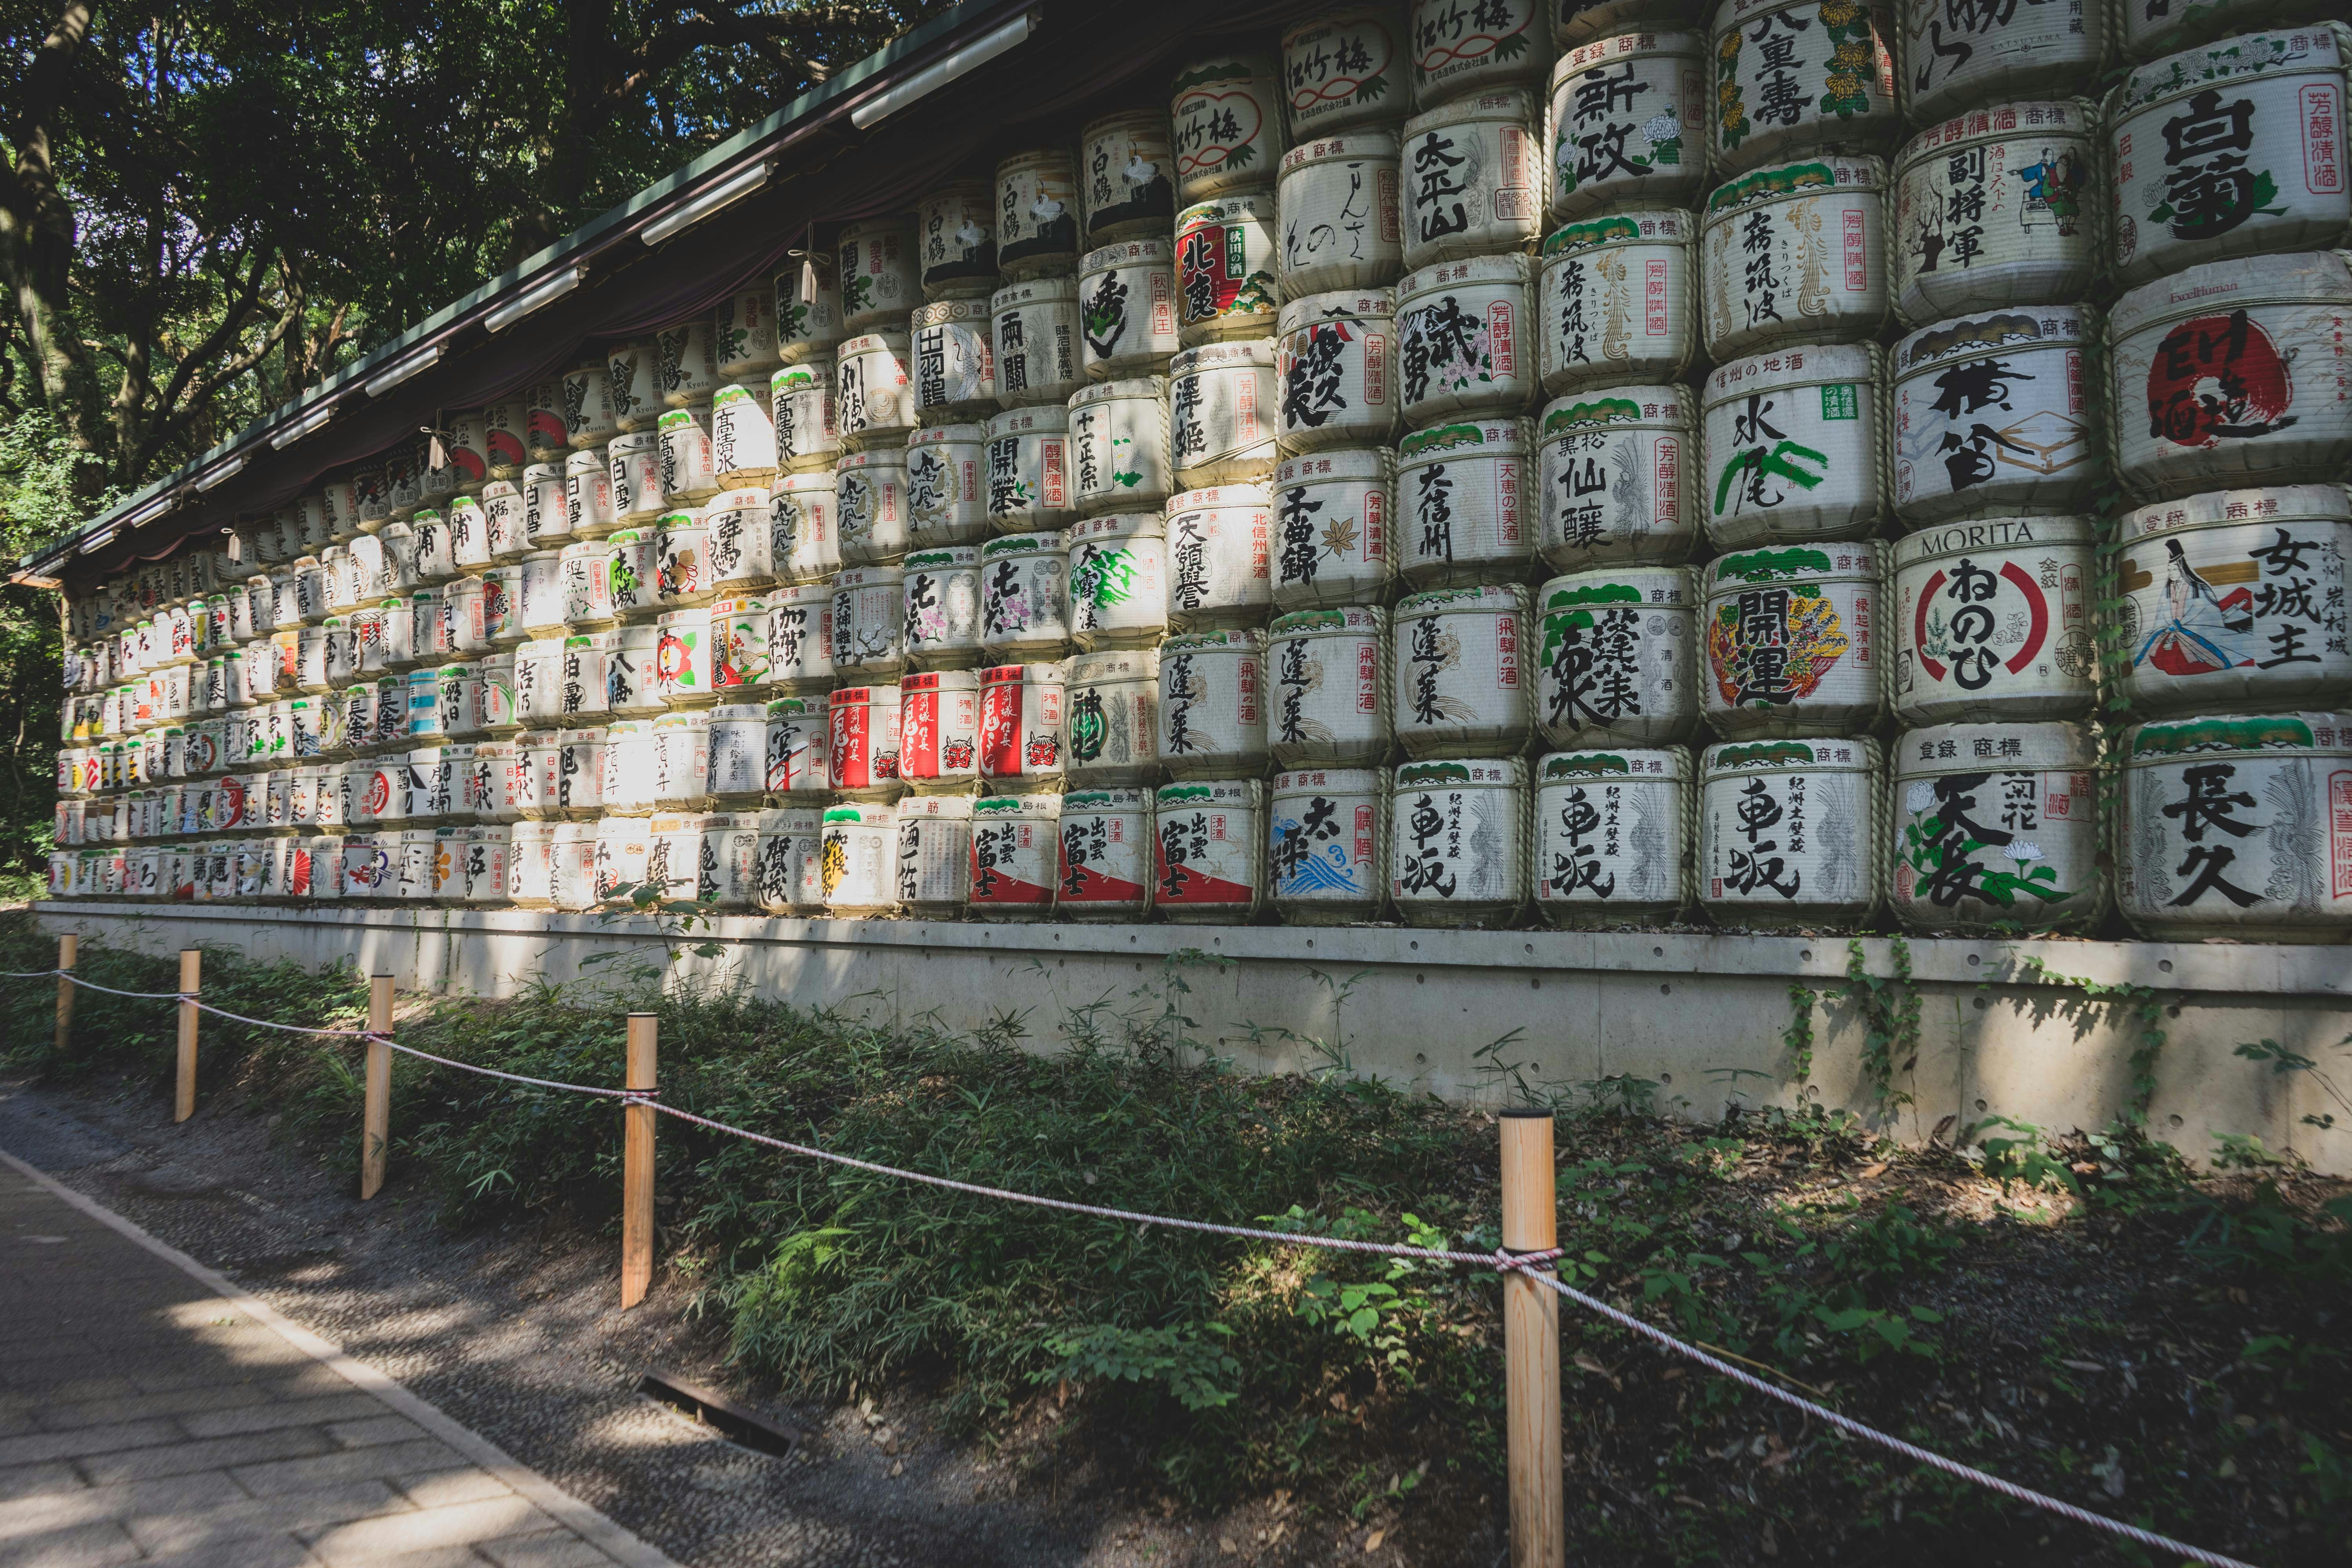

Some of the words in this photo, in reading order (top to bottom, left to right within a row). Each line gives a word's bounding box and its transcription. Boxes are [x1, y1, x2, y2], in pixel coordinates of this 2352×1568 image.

[1416, 0, 1514, 58] 松竹梅
[1572, 34, 1657, 67] 登録商標
[1991, 34, 2060, 51] KATSUYAMA
[2290, 34, 2330, 51] 商標
[1287, 35, 1374, 96] 松竹梅
[1479, 95, 1511, 111] 商標
[1572, 62, 1654, 183] 新政
[1687, 78, 1702, 122] 清酒
[2025, 107, 2065, 125] 商標
[1285, 140, 1344, 169] 登録商標
[1924, 108, 2016, 149] 芳醇清酒
[2308, 92, 2336, 187] 芳醇清酒
[1093, 145, 1112, 207] 白鶴
[1415, 132, 1468, 243] 太平山
[1834, 169, 1871, 185] 商標
[2161, 90, 2257, 240] 白菊
[1003, 183, 1020, 241] 白鶴
[1227, 201, 1256, 215] 商標
[1639, 220, 1677, 235] 商標
[1946, 146, 1986, 268] 副将軍
[928, 208, 946, 263] 白鶴
[1229, 231, 1242, 274] 秋田の酒
[1846, 215, 1864, 285] 芳醇清酒
[1183, 234, 1217, 321] 北鹿
[1743, 212, 1783, 331] 霧筑波
[1781, 239, 1792, 298] きりつくば
[2171, 282, 2238, 304] ExcelHuman
[994, 289, 1032, 308] 登録商標
[1154, 276, 1170, 331] 秋田酒王
[1358, 299, 1388, 313] 商標
[1560, 261, 1590, 372] 霧筑波
[1590, 287, 1599, 342] きりつくば
[1649, 265, 1664, 330] 芳醇清酒
[1492, 305, 1512, 372] 芳醇清酒
[2042, 319, 2080, 336] 商標
[687, 381, 709, 389] Kyoto
[894, 358, 908, 385] 清酒
[919, 327, 946, 408] 出羽鶴
[1368, 340, 1382, 399] 芳醇清酒
[1716, 353, 1803, 389] 信州の地酒
[823, 399, 835, 436] 品質本位
[1240, 379, 1254, 442] 芳醇清酒
[1486, 428, 1519, 442] 商標
[1642, 403, 1680, 419] 商標
[700, 438, 711, 472] 品質本位
[1077, 412, 1098, 491] 十一正宗
[1733, 391, 1788, 517] 水尾
[613, 459, 632, 511] 白雪
[1169, 490, 1220, 512] 登録商標
[1500, 464, 1519, 541] 天恵の美酒
[1659, 445, 1676, 517] 芳醇清酒
[525, 485, 541, 534] 白雪
[1278, 486, 1326, 585] 千曲錦
[1369, 496, 1382, 554] 芳醇清酒
[1416, 463, 1453, 563] 大信州
[2145, 510, 2185, 534] 登録
[2227, 499, 2279, 519] 商標
[1252, 514, 1268, 579] 北信州清酒
[1838, 555, 1872, 571] 商標
[1922, 522, 2033, 555] MORITA
[1651, 589, 1682, 604] 商標
[1948, 558, 2000, 690] ねのひ
[2064, 577, 2082, 619] 清酒
[2248, 527, 2321, 670] 女城主
[836, 592, 852, 665] 天神囃子
[1499, 617, 1517, 684] 飛騨の酒
[1734, 590, 1801, 706] 開運
[1856, 598, 1870, 662] 縁起清酒
[1241, 662, 1256, 720] 飛騨の酒
[1359, 647, 1376, 710] 飛騨の酒
[1661, 649, 1673, 690] 清酒
[1044, 693, 1058, 720] 清酒
[812, 738, 823, 767] 清酒
[1631, 759, 1663, 773] 商標
[1816, 748, 1851, 762] 商標
[1920, 737, 2022, 760] 登録商標
[505, 768, 514, 805] 日本酒
[547, 757, 555, 796] 日本酒
[1214, 789, 1241, 798] 島根
[1274, 773, 1326, 790] 登録商標
[2001, 771, 2037, 830] 菊花
[1000, 822, 1016, 864] 出雲
[1190, 813, 1208, 859] 出雲
[1212, 817, 1224, 839] 清酒
[1357, 811, 1372, 856] 清酒
[1401, 791, 1457, 898] 車坂
[1550, 784, 1615, 899] 車坂
[1724, 775, 1800, 898] 車坂
[2162, 762, 2272, 908] 長久
[898, 820, 920, 900] 酒一筋
[975, 829, 999, 898] 富士
[1162, 820, 1189, 898] 富士
